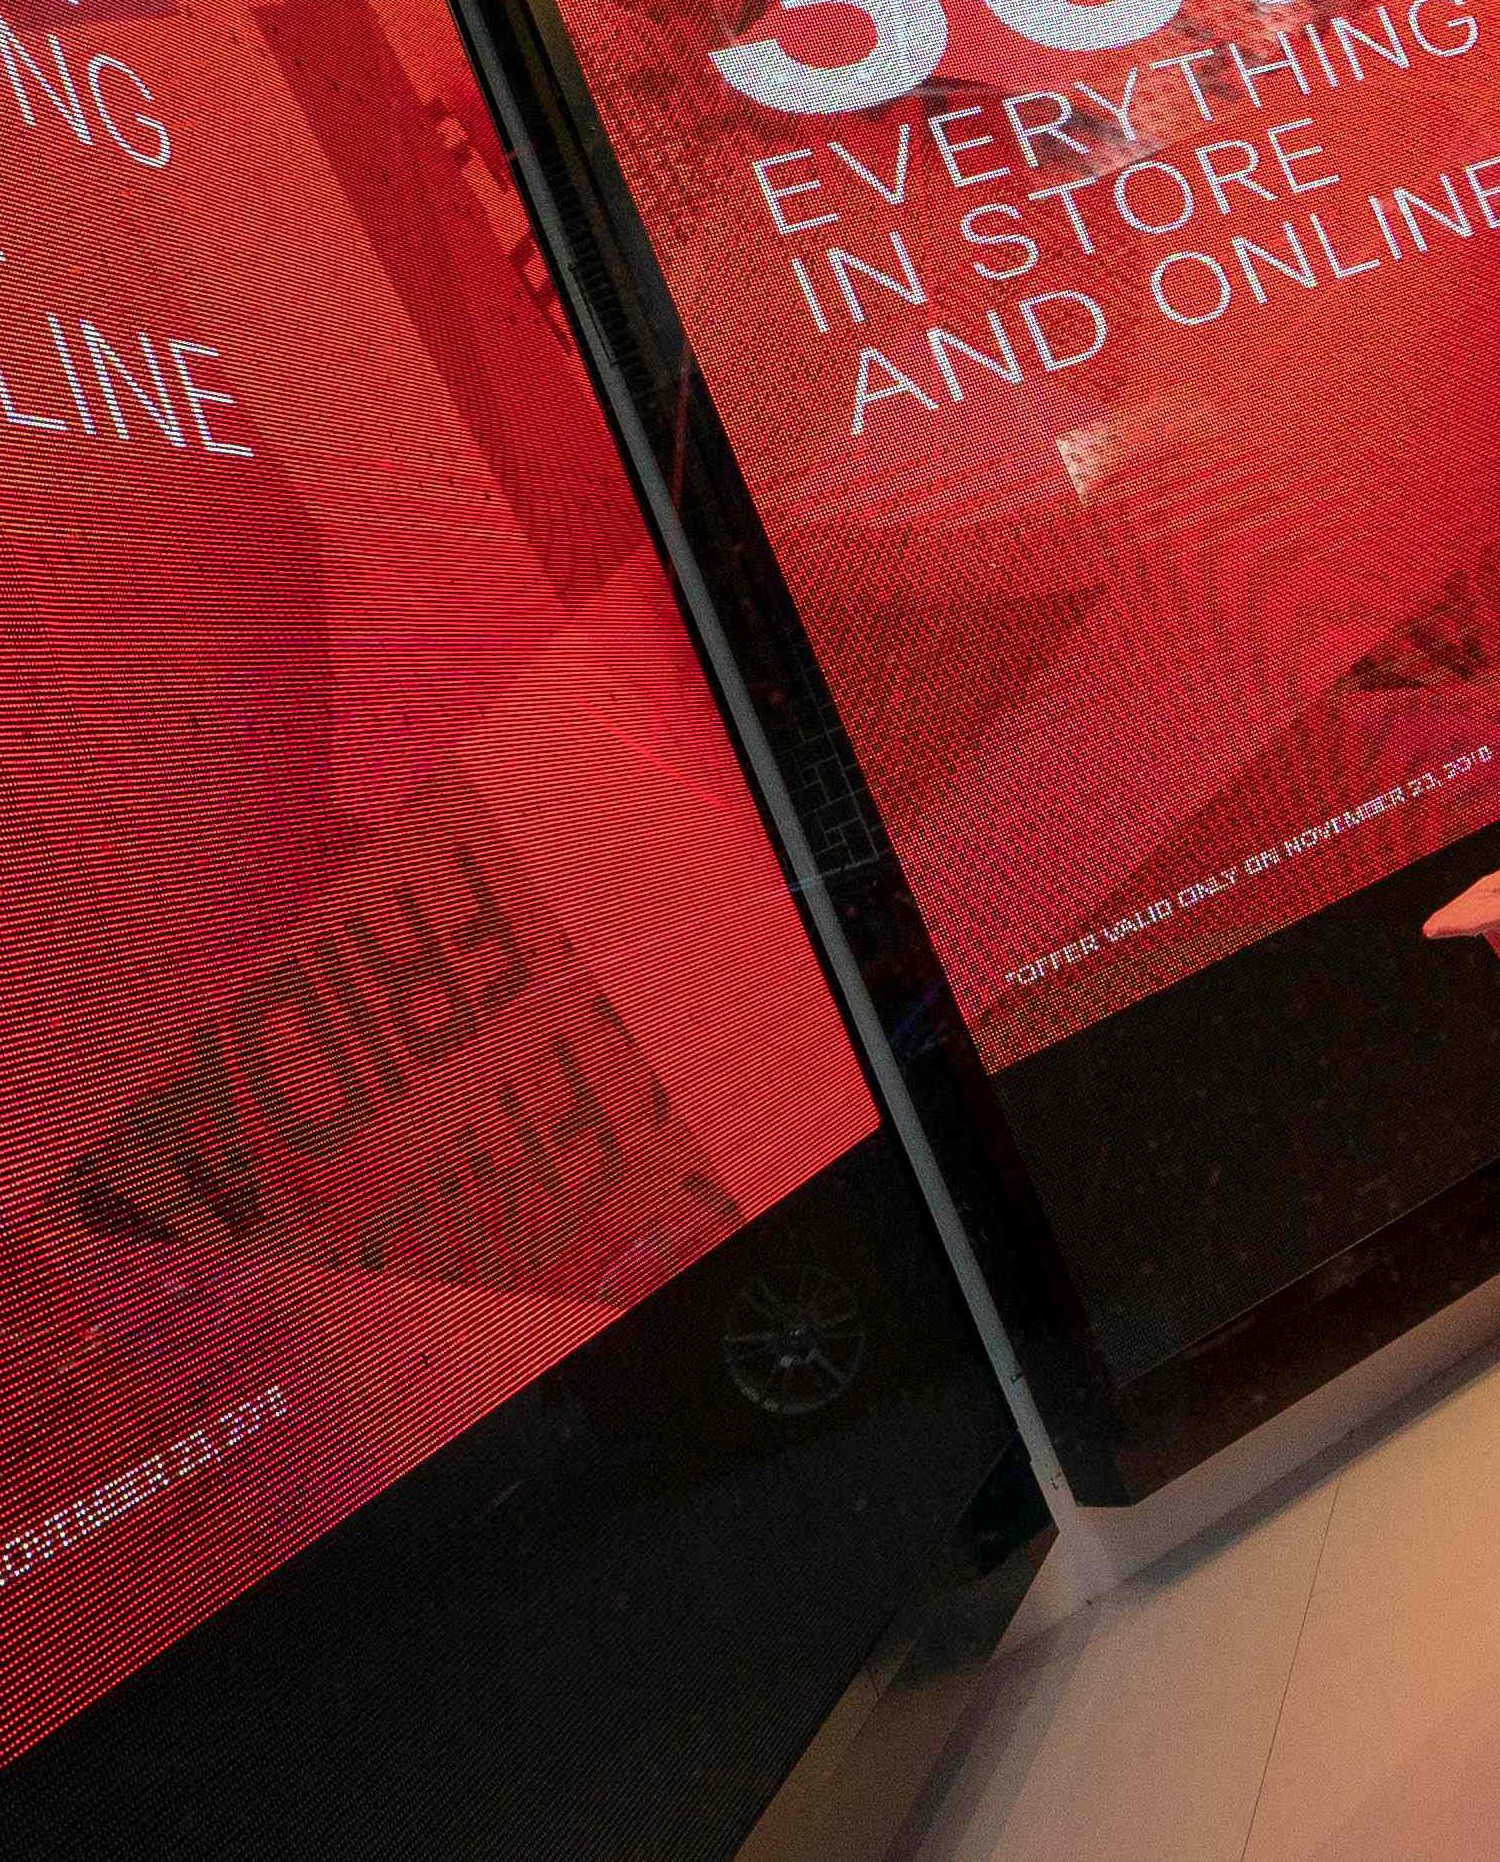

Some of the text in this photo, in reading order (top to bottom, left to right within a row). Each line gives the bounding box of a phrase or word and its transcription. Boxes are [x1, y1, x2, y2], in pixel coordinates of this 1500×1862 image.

[789, 117, 1341, 335] IN STORE
[850, 290, 1109, 437] AND
[1102, 899, 1173, 942] VALID
[1176, 867, 1240, 909] ONLY
[1243, 846, 1281, 876] ON
[1284, 784, 1407, 859] NOVEMBER
